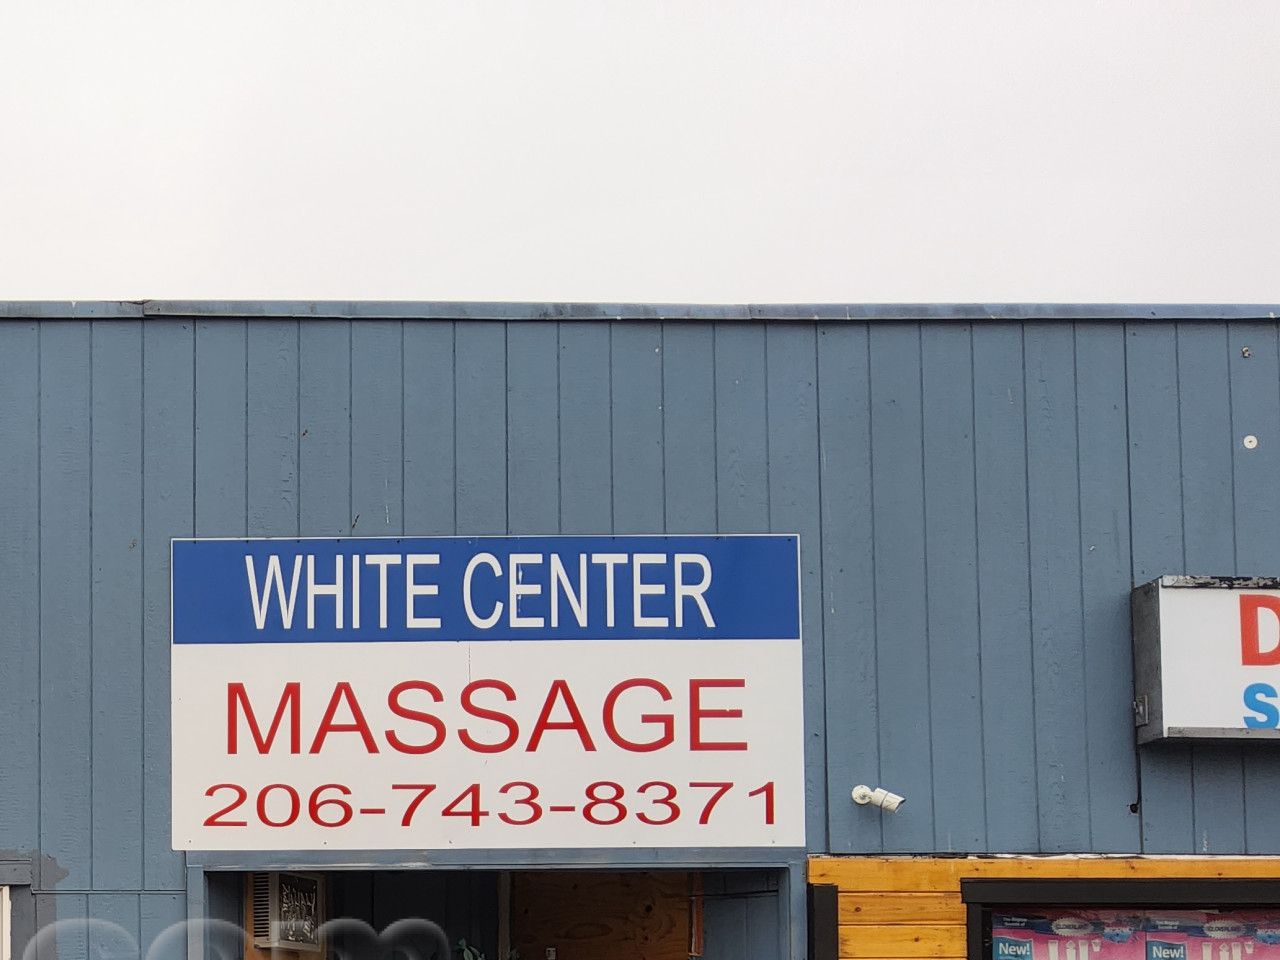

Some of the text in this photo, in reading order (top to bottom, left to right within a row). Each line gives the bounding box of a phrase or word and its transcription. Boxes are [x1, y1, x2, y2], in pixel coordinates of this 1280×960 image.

[246, 552, 716, 630] WHITE CENTER
[226, 678, 749, 755] MASSAGE
[202, 780, 776, 828] 206-743-8371
[999, 942, 1031, 955] New!
[1152, 945, 1184, 958] New!
